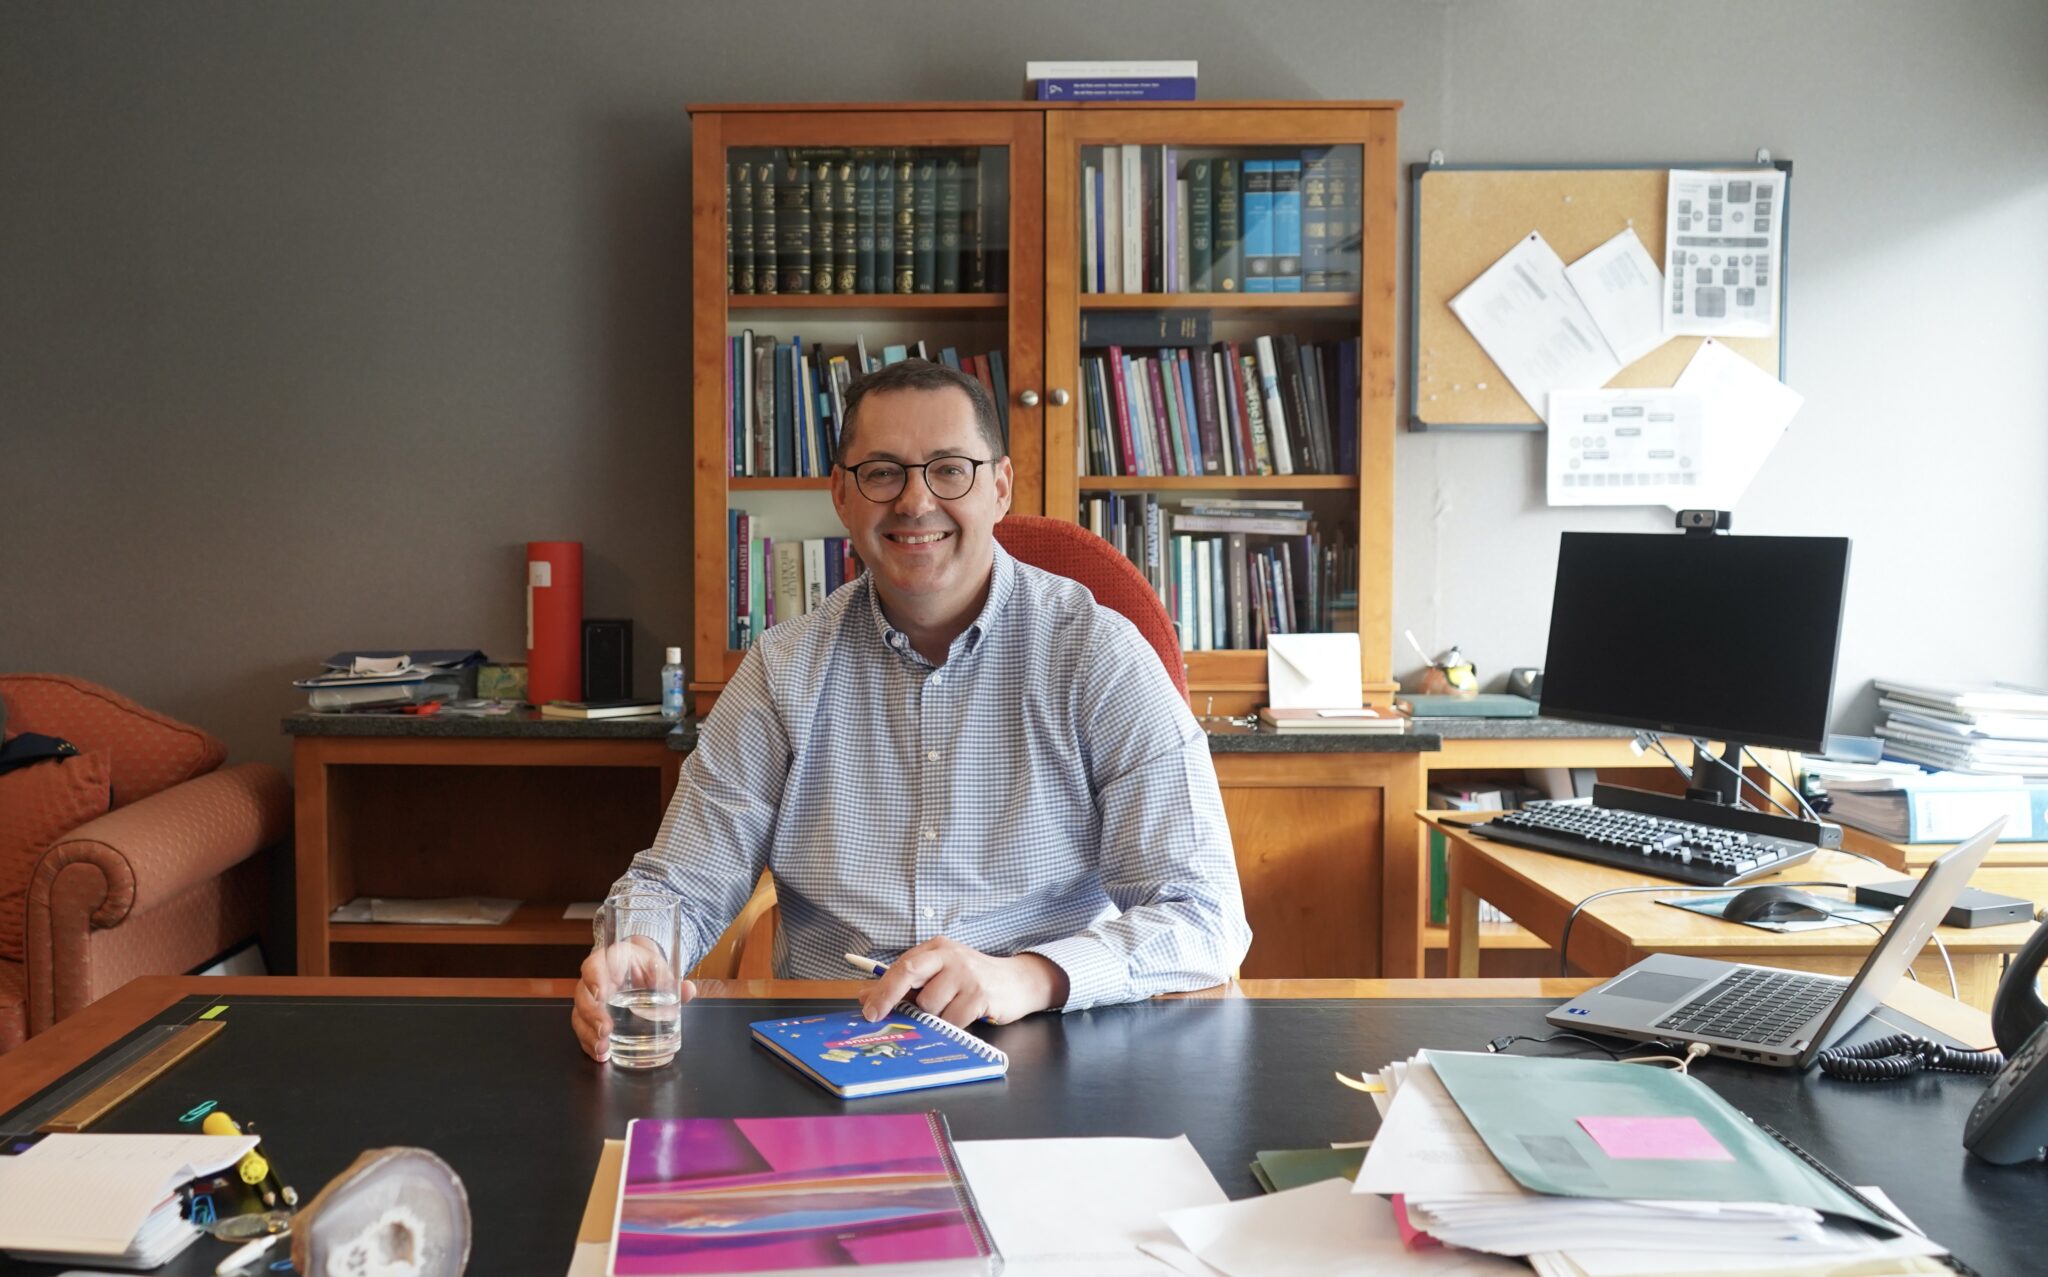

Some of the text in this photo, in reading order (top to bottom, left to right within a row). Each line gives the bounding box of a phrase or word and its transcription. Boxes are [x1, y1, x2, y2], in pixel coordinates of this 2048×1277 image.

[1252, 419, 1267, 444] IRA
[1147, 503, 1158, 567] MALVINAS
[739, 544, 748, 570] IRISH
[780, 550, 789, 594] BECKETT
[788, 558, 797, 597] SAMUEL
[838, 1033, 905, 1046] Erasmus+
